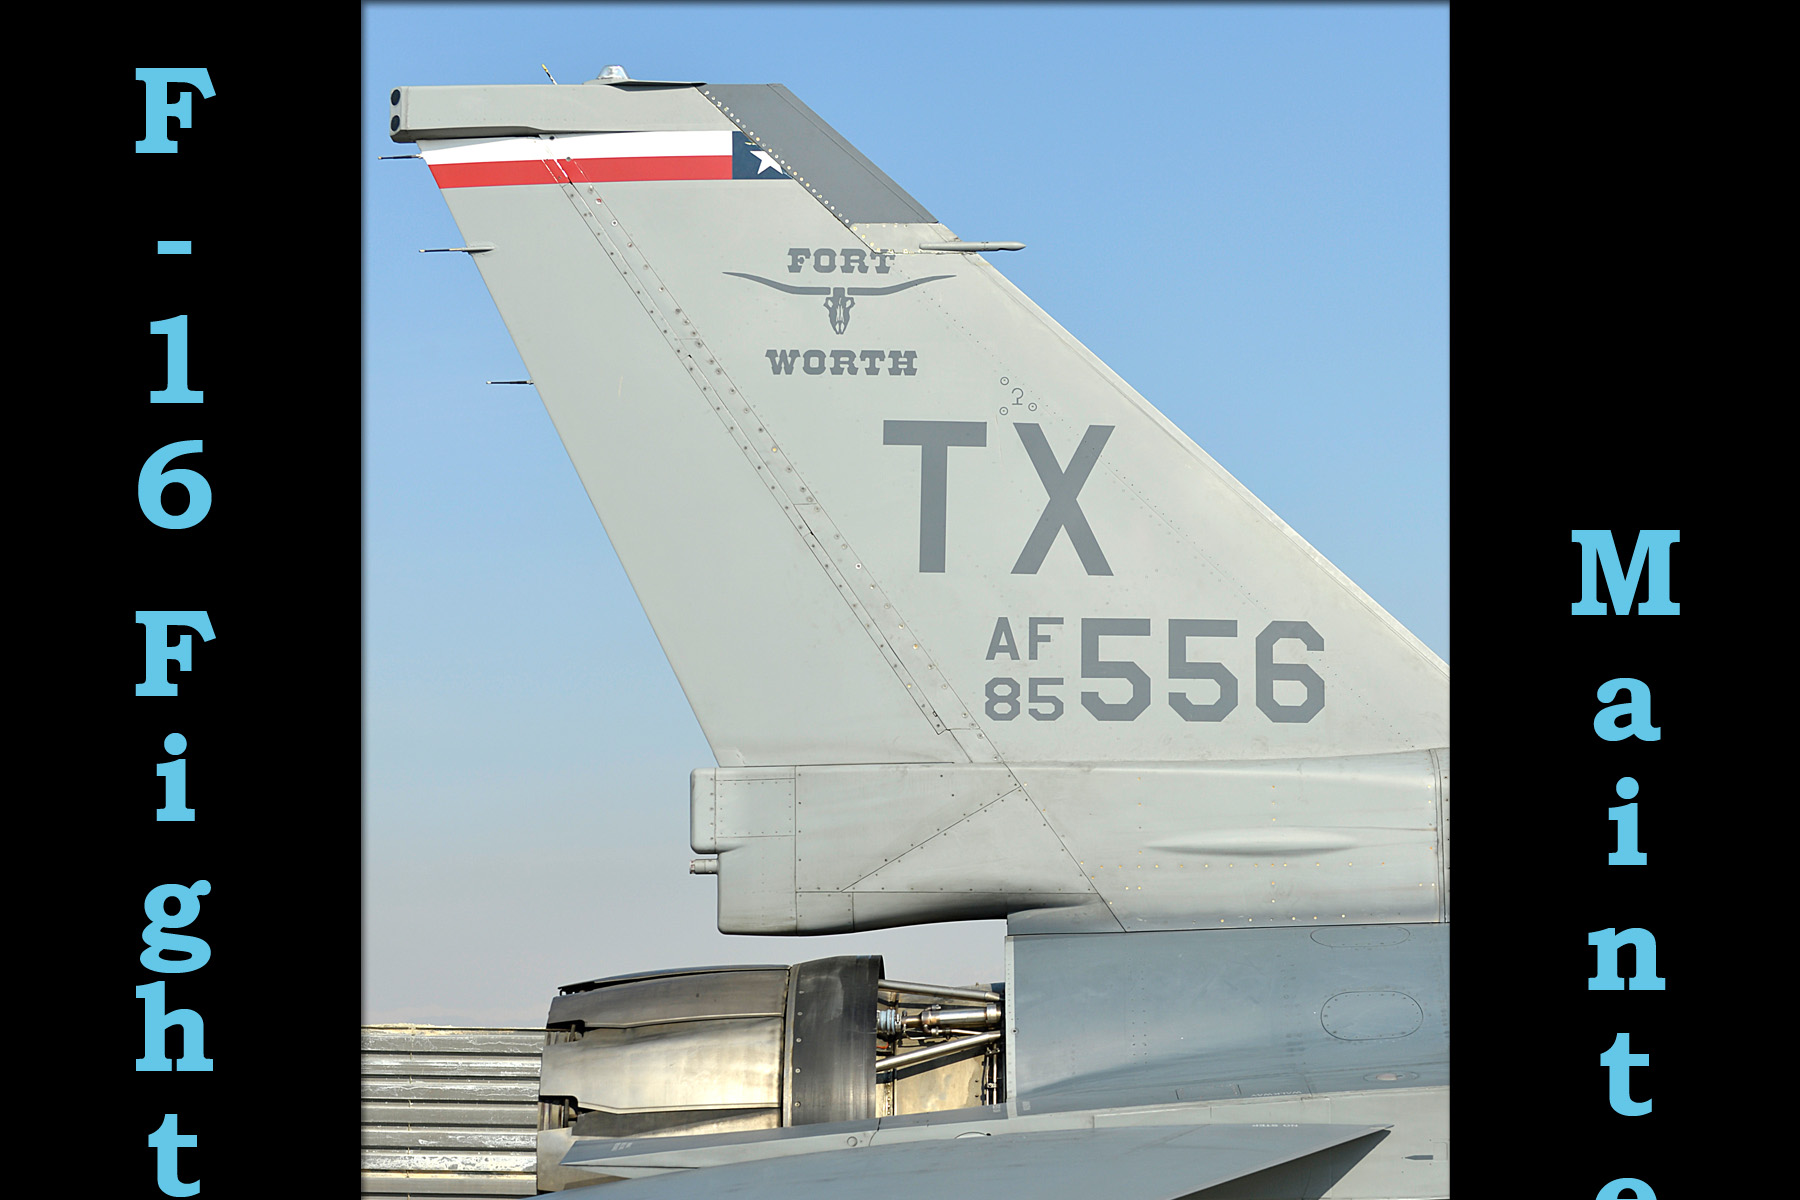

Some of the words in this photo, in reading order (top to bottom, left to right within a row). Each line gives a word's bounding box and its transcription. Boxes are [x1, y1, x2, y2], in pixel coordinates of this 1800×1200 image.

[787, 248, 896, 274] FORT
[766, 349, 918, 376] WORTH
[883, 419, 1116, 577] TX
[985, 617, 1064, 661] AF
[1081, 618, 1326, 724] 556
[985, 677, 1065, 722] 85
